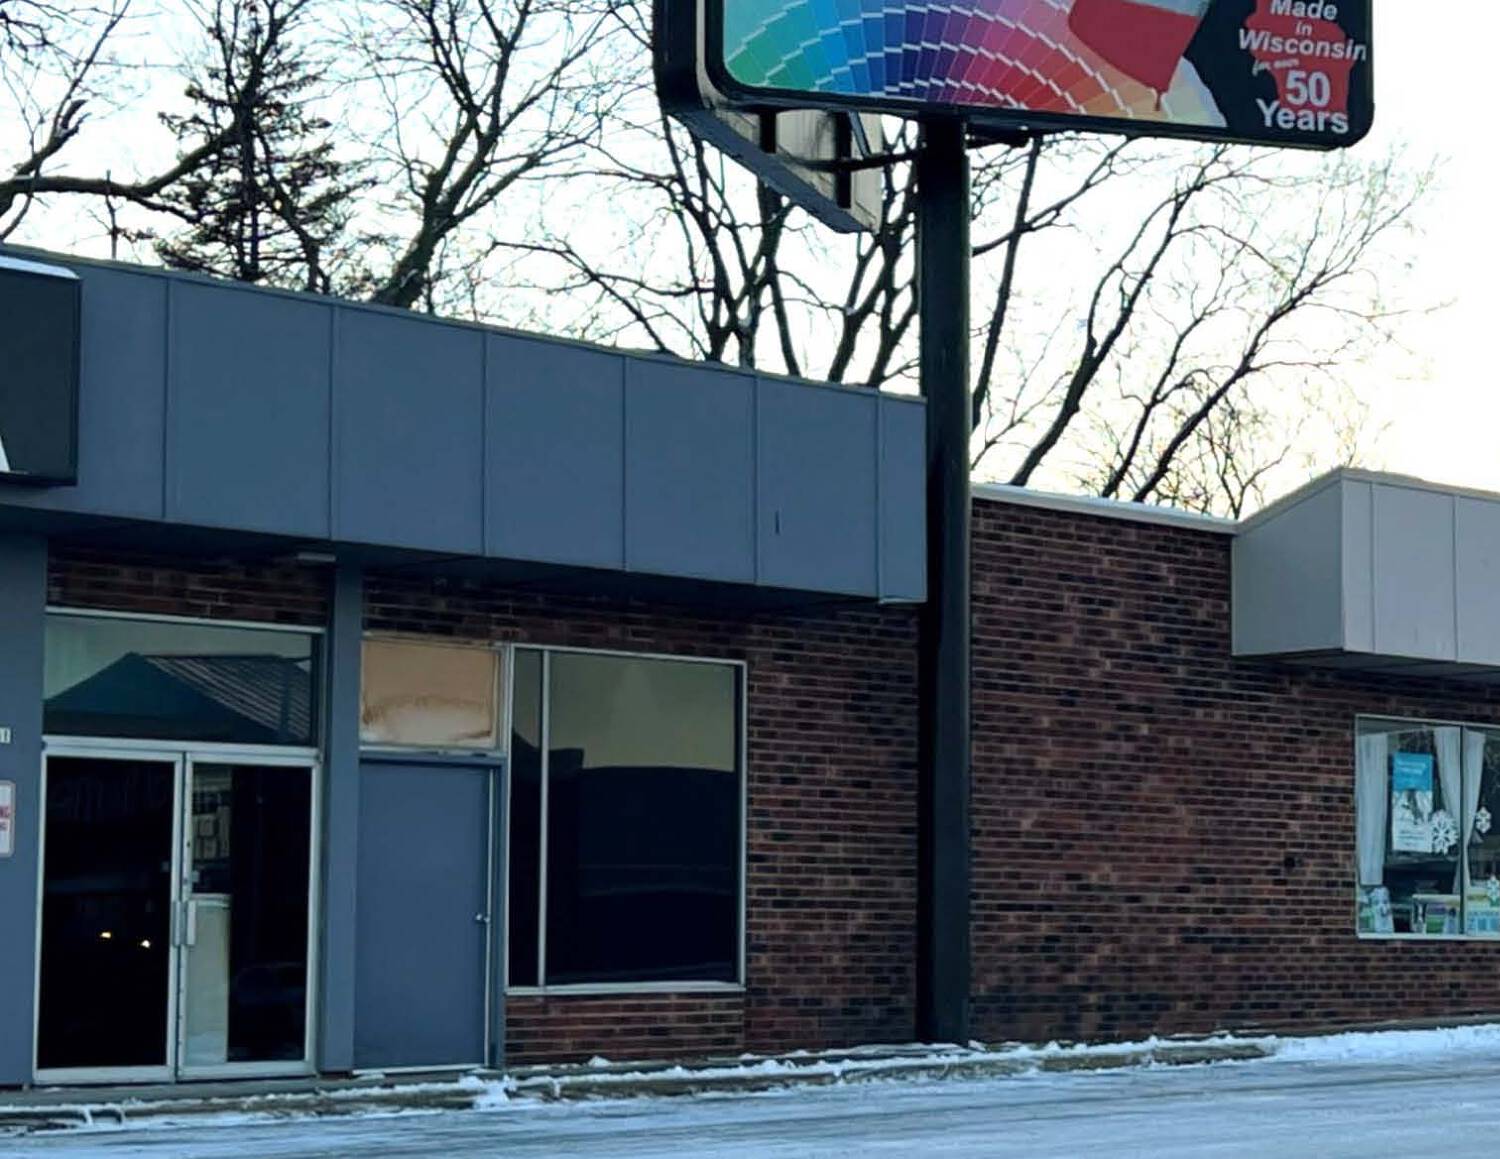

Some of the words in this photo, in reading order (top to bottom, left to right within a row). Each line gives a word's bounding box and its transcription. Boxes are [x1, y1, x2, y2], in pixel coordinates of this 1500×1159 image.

[1270, 0, 1338, 20] Made
[1238, 28, 1367, 61] Wisconsin
[1295, 20, 1313, 36] in
[1285, 69, 1331, 108] 50
[1256, 98, 1350, 134] Years
